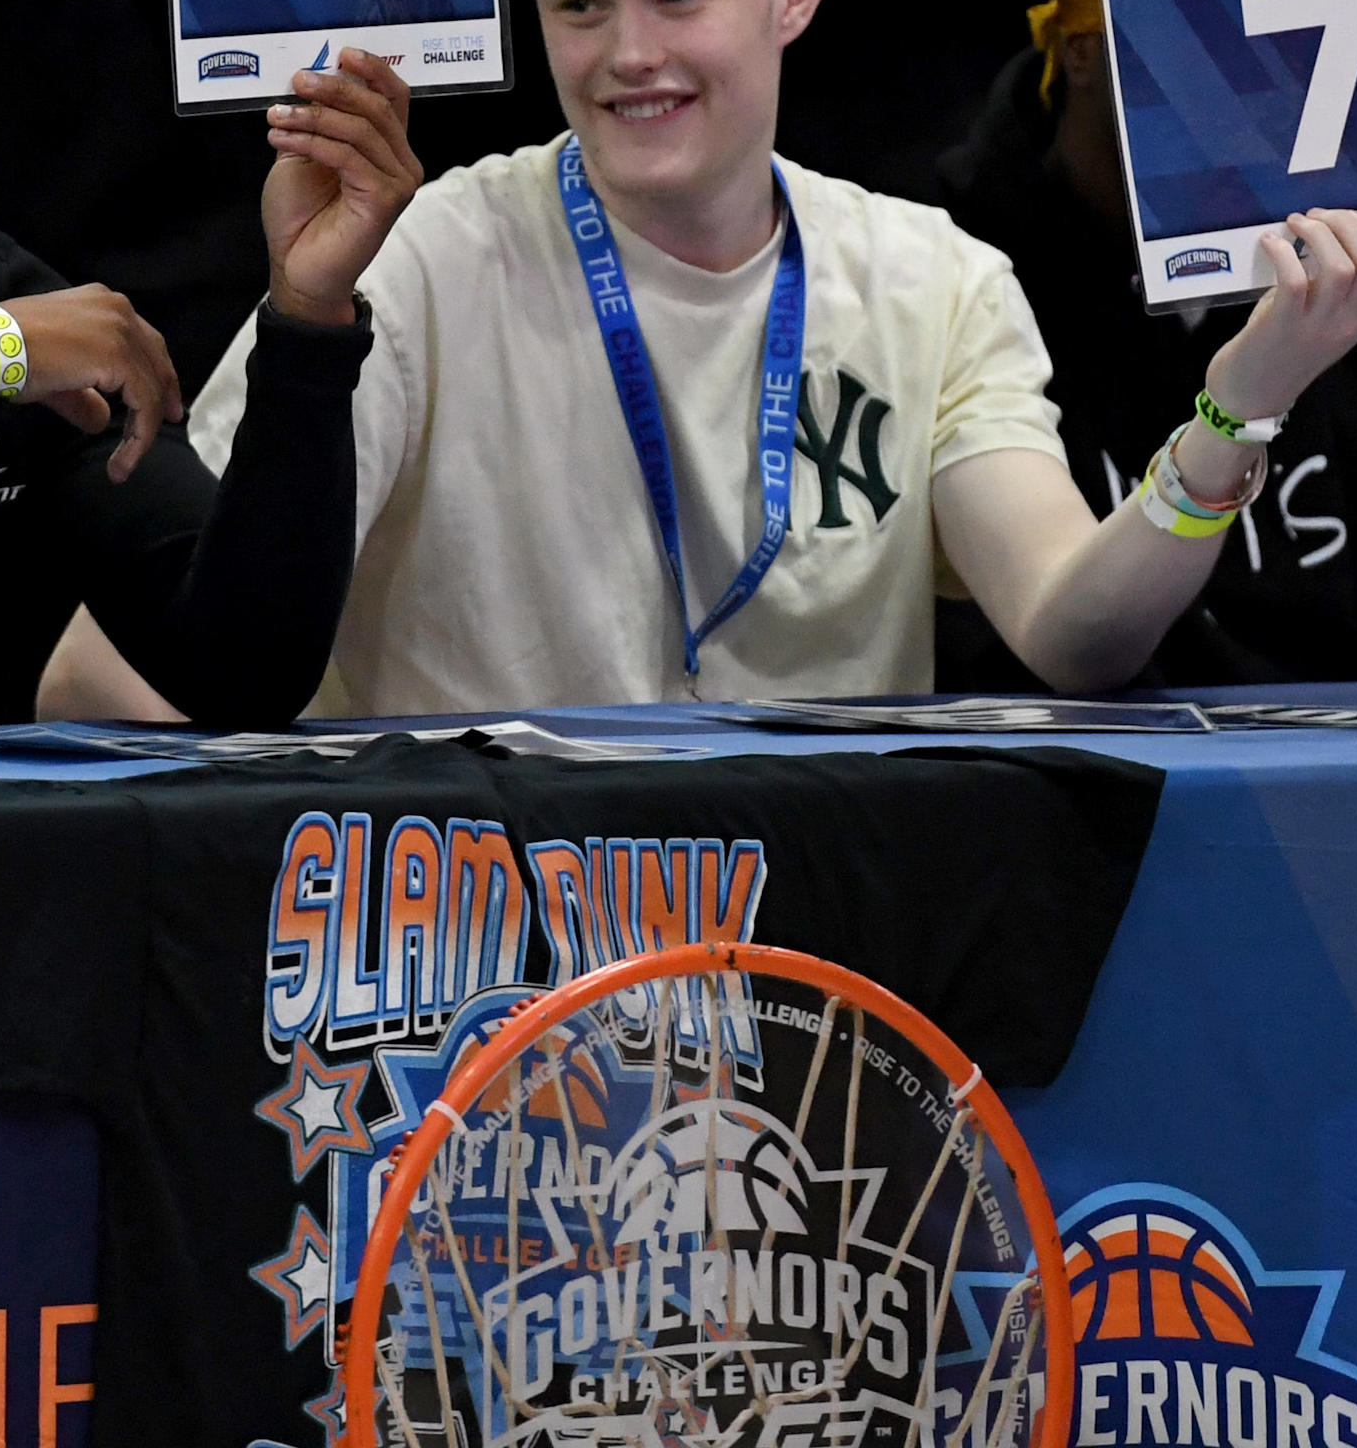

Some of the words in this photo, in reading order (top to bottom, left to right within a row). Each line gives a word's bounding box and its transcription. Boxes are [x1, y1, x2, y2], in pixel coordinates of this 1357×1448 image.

[201, 53, 257, 76] GOVERNORS
[423, 49, 485, 64] CHALLENGE
[448, 37, 462, 49] TO
[464, 35, 484, 48] THE
[570, 198, 604, 241] TO
[587, 249, 628, 318] THE
[1168, 250, 1228, 275] GOVERNORS
[762, 371, 793, 437] THE
[762, 449, 786, 488] TO
[266, 812, 530, 1052] SLAM
[527, 837, 764, 1082] DUNK
[855, 1036, 897, 1077] RISE
[894, 1065, 922, 1097] TO
[919, 1090, 955, 1134] THE
[509, 1249, 909, 1403] GOVERNORS
[570, 1358, 848, 1404] CHALLENGE
